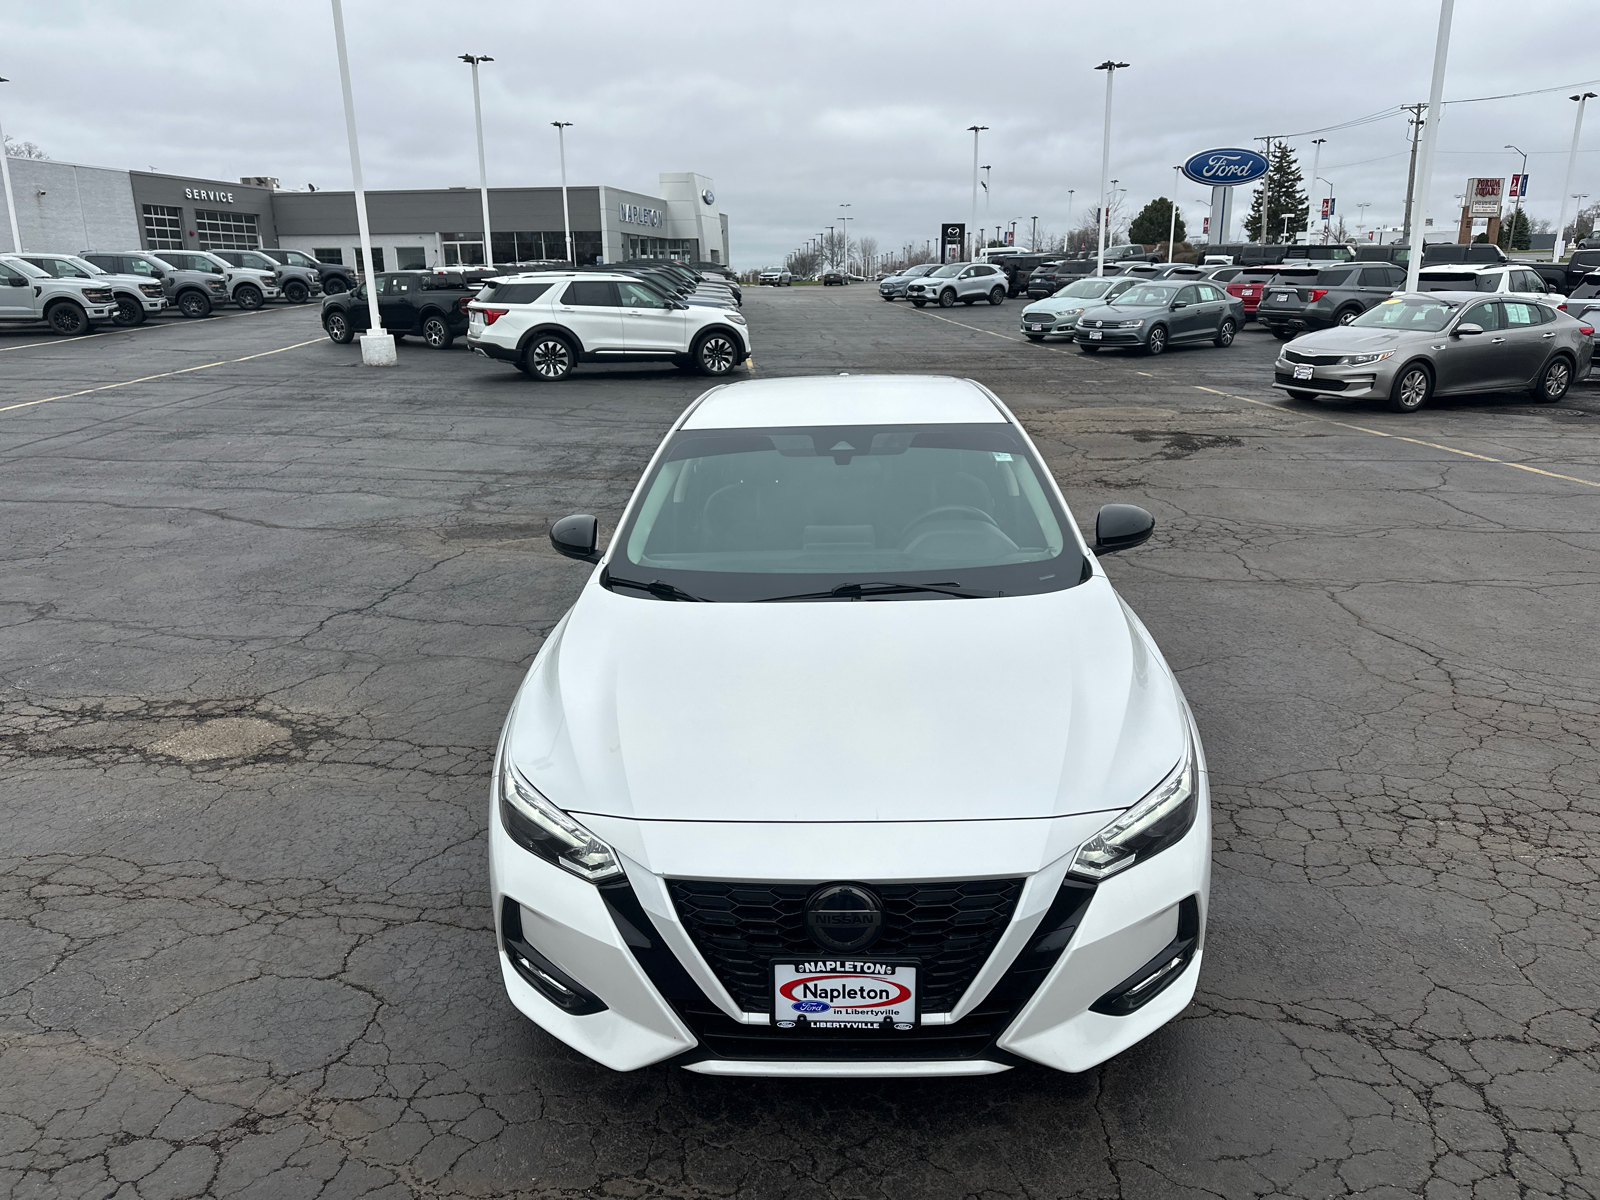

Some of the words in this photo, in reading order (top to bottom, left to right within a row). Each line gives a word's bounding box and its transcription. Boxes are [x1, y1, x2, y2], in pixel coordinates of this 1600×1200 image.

[1203, 155, 1252, 177] Ford
[185, 188, 234, 203] SERVICE
[1475, 187, 1500, 197] SQUARE
[619, 203, 663, 227] NAPLETON
[815, 912, 874, 925] NISSAN
[803, 961, 887, 975] NAPLETON
[802, 983, 890, 1003] Napleton
[799, 1002, 824, 1012] Ford
[845, 1008, 900, 1017] Libertyville
[810, 1021, 880, 1029] LIBERTYVILLE
